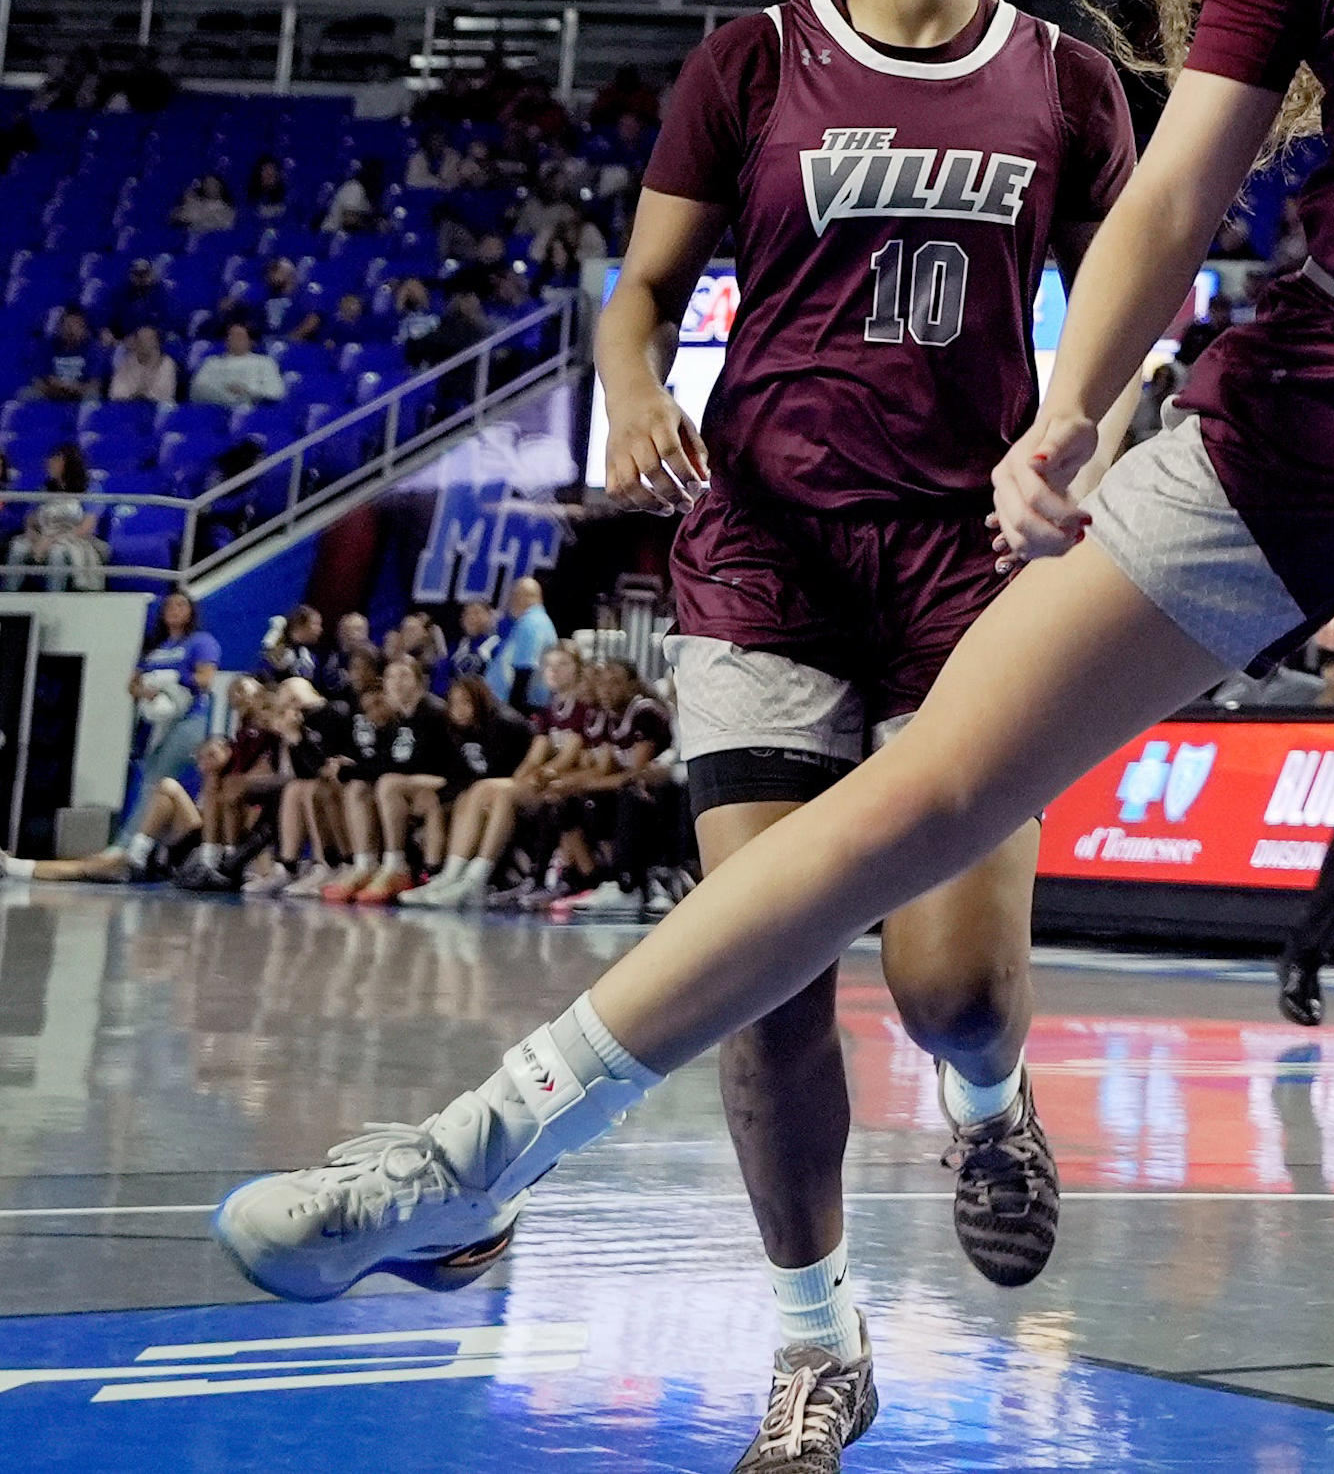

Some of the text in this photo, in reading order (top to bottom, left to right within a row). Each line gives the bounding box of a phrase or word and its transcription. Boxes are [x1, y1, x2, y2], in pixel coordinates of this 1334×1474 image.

[821, 128, 897, 152] THE
[800, 148, 1037, 237] VILLE
[864, 240, 969, 347] 10
